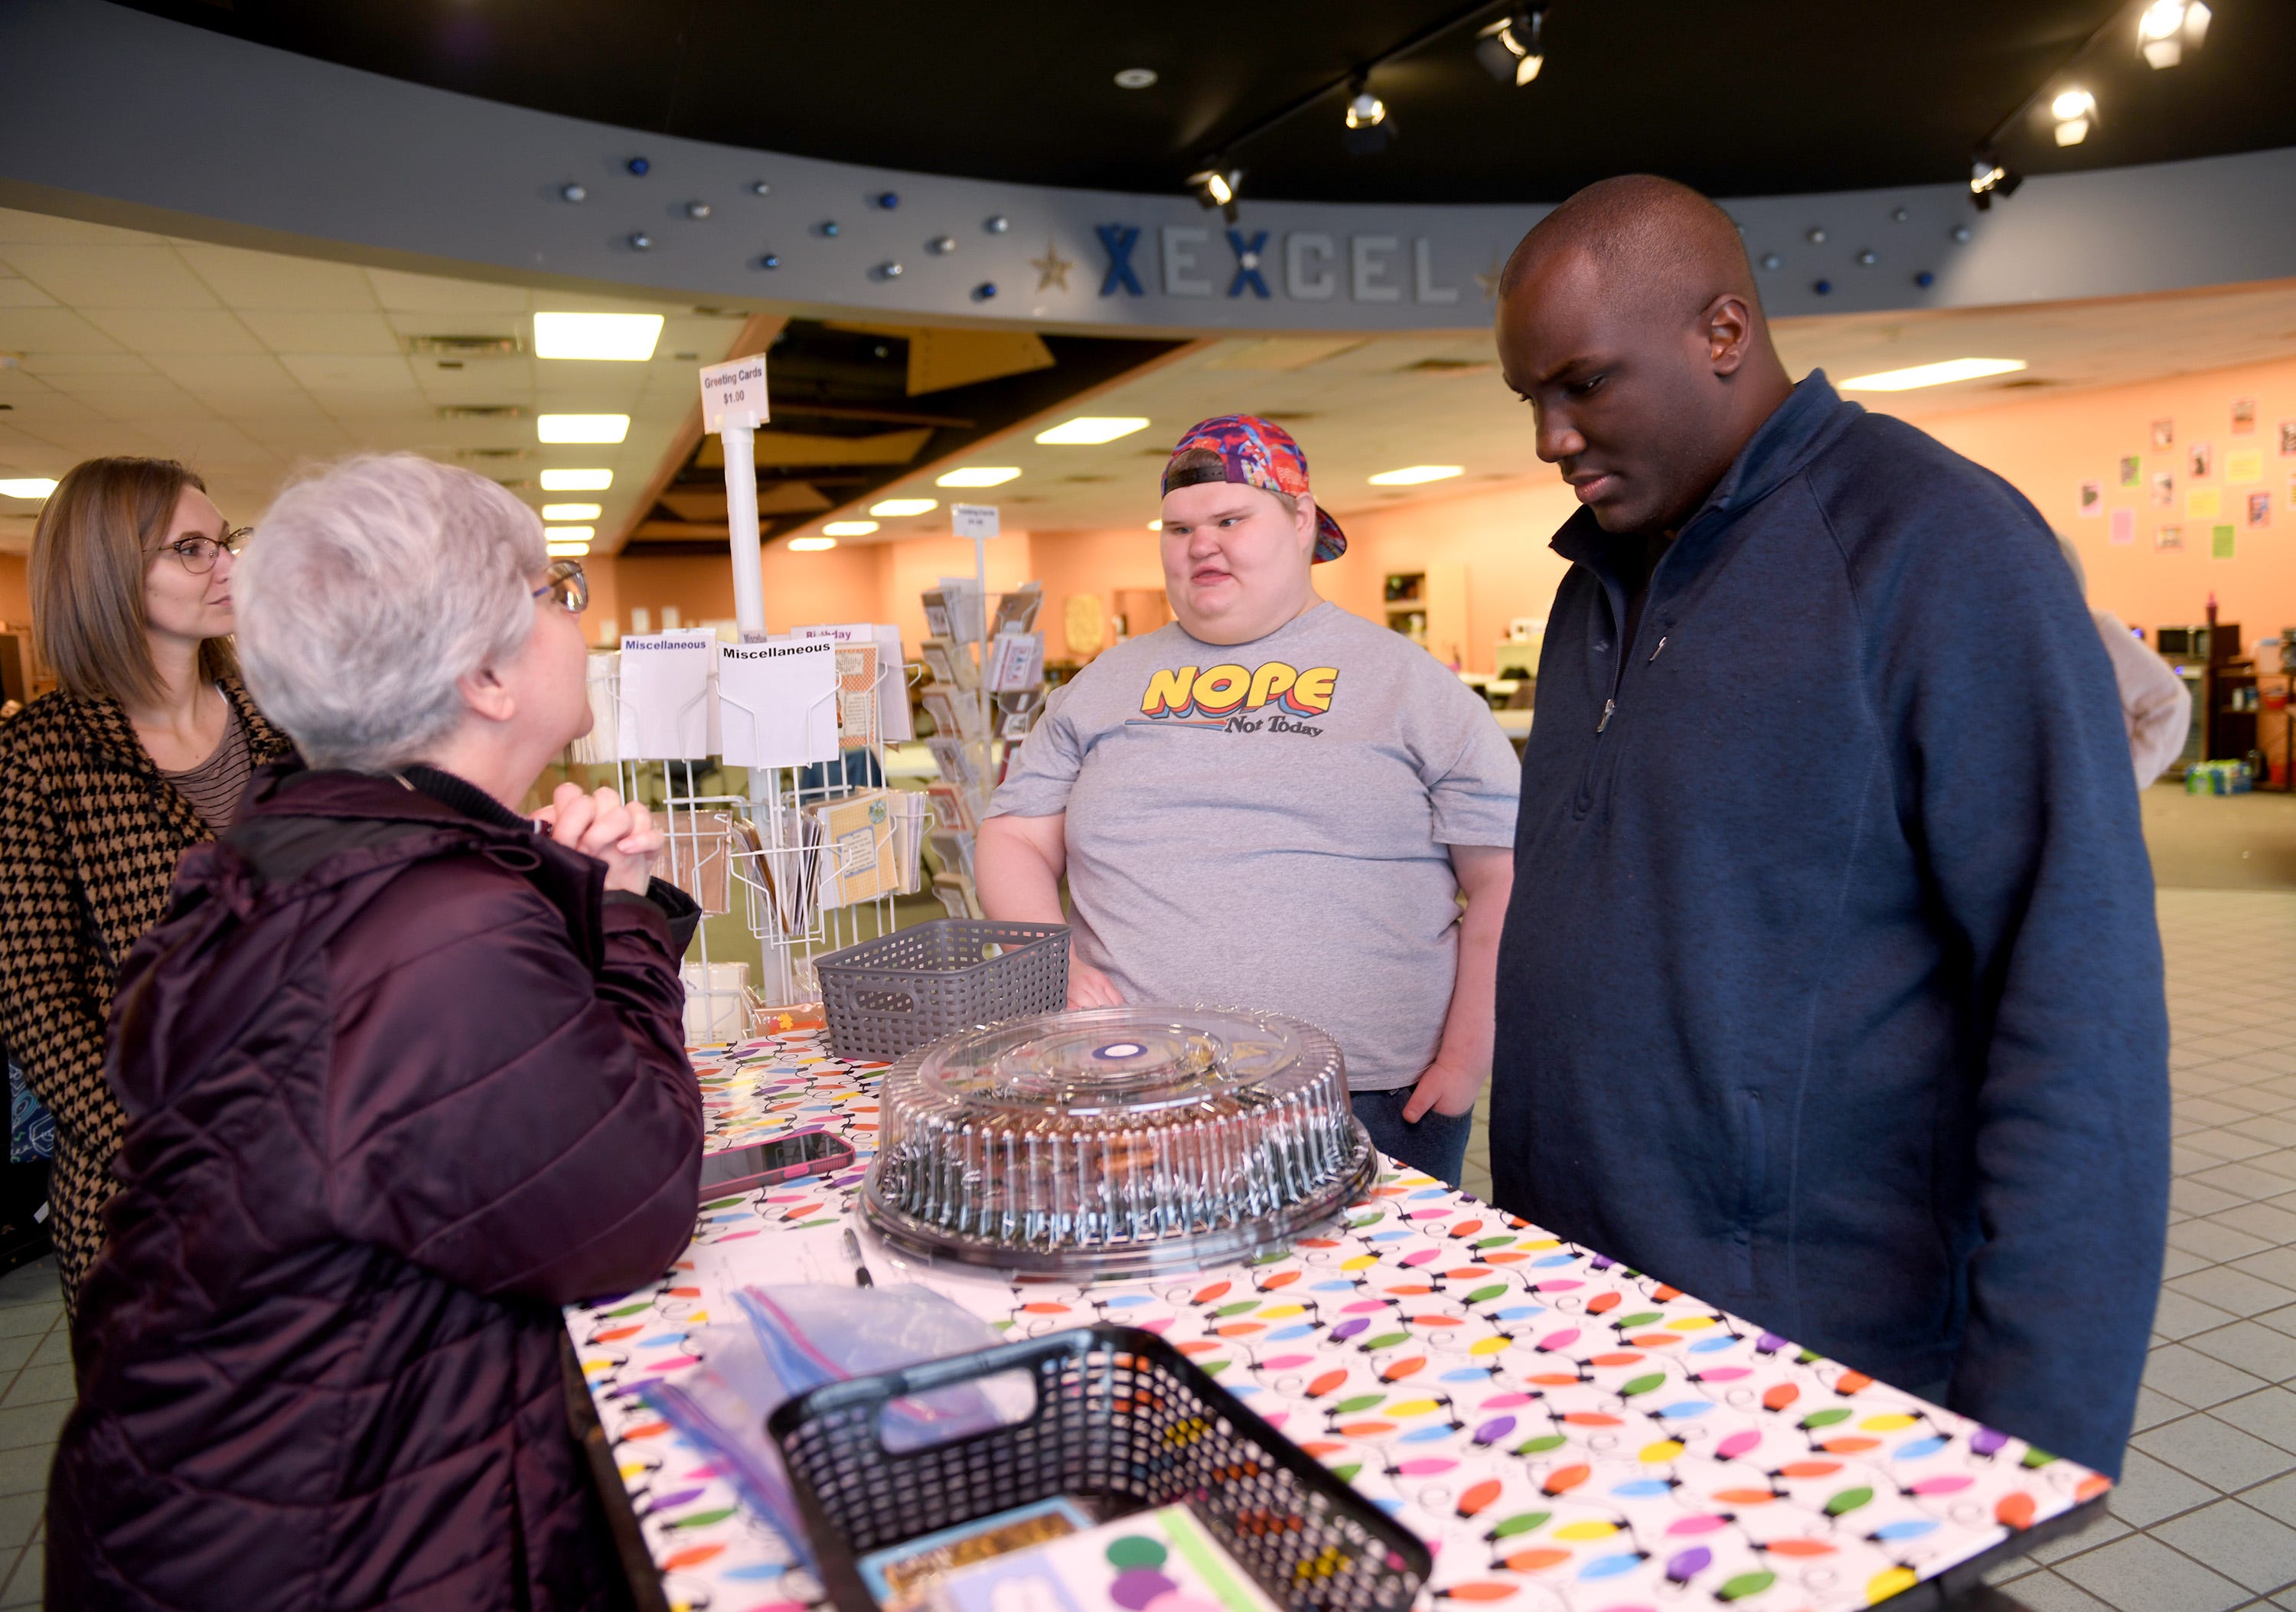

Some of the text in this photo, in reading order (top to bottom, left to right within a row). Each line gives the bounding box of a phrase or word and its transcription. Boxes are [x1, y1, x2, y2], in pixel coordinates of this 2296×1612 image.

[705, 367, 762, 388] Greeting Cards
[723, 390, 745, 406] $1.00
[625, 640, 706, 650] Miscellaneous
[723, 643, 830, 660] Miscellaneous
[1140, 661, 1339, 720] NOPE
[1225, 716, 1323, 737] Not Today
